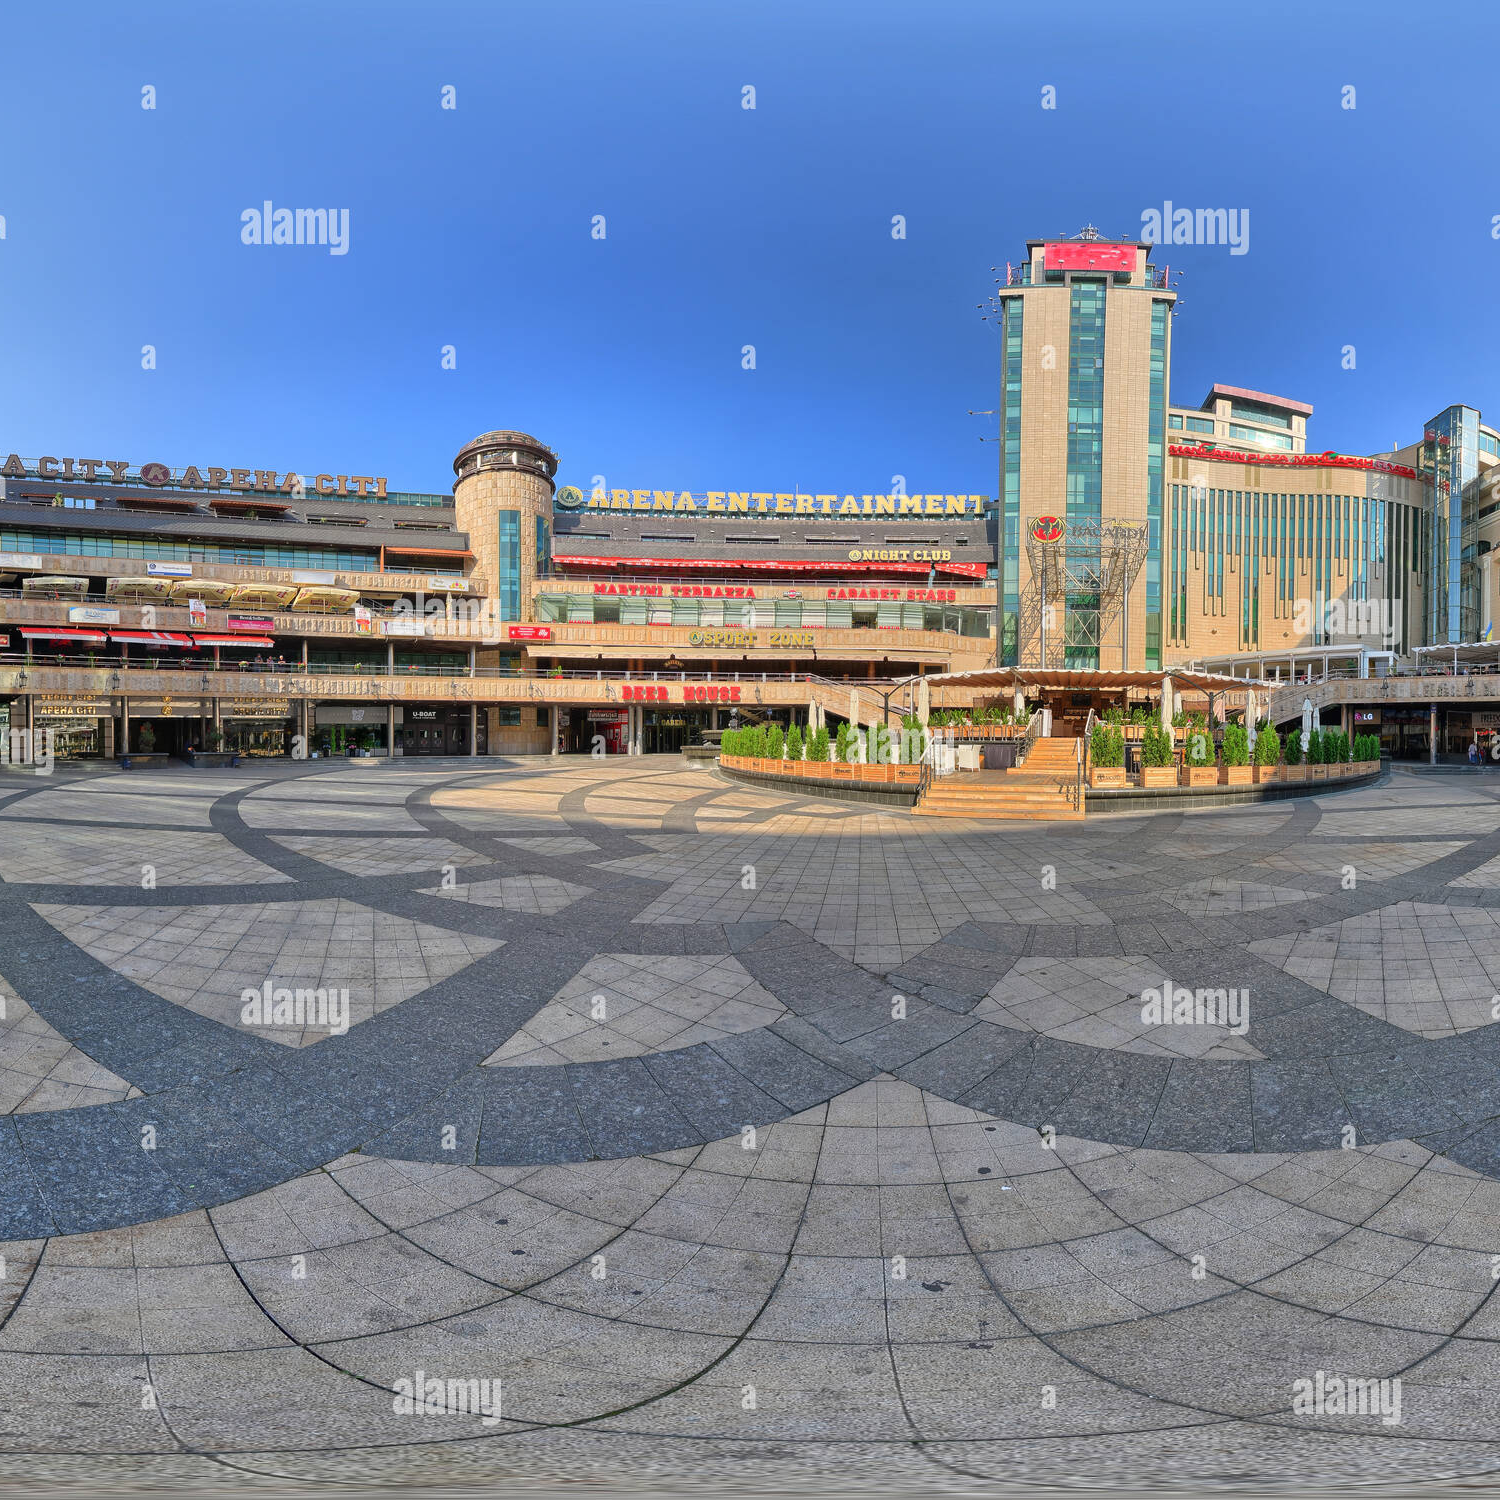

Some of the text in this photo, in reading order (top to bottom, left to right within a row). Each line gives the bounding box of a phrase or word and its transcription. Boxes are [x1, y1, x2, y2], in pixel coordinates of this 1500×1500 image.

[1169, 443, 1289, 463] MANDARIN PLAZA
[38, 456, 130, 481] CITY
[588, 489, 982, 514] ARENA ENTERTAINMENT
[1072, 526, 1143, 540] BACARDI
[862, 550, 951, 561] NIGHT CLUB
[594, 583, 756, 599] MARTINI TERRAZZA
[827, 588, 956, 602] CABARET STARS
[704, 632, 815, 646] SPORT ZONE
[622, 685, 741, 702] BEER HOUSE
[1363, 712, 1373, 721] LG
